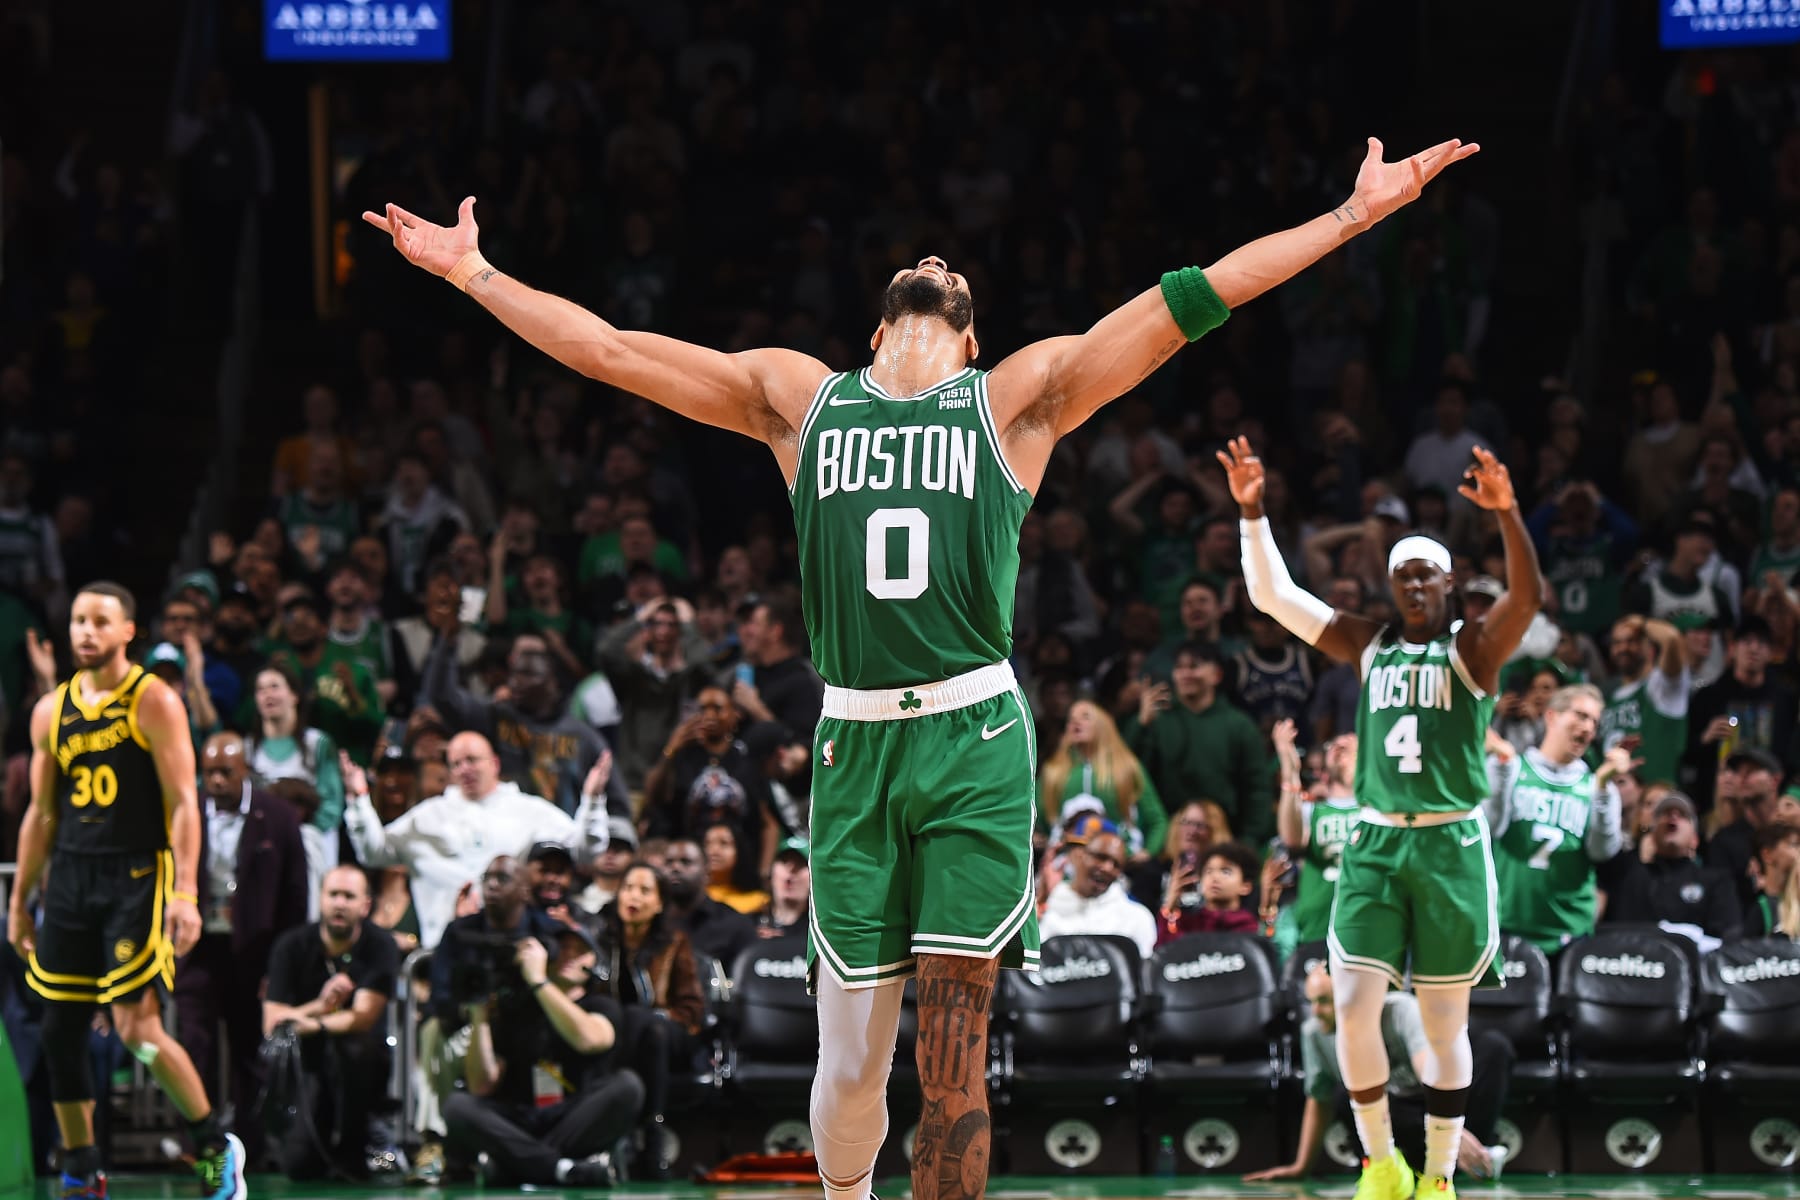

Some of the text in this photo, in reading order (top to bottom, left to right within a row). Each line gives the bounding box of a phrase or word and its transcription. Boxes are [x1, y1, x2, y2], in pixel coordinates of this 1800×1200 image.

[938, 399, 972, 410] PRINT
[939, 387, 972, 400] VISTA
[817, 424, 977, 501] BOSTON
[865, 507, 930, 600] 0
[1369, 663, 1453, 714] BOSTON
[1384, 714, 1422, 774] 4
[70, 763, 118, 808] 30
[1513, 785, 1590, 838] BOSTON
[1528, 823, 1564, 870] 7
